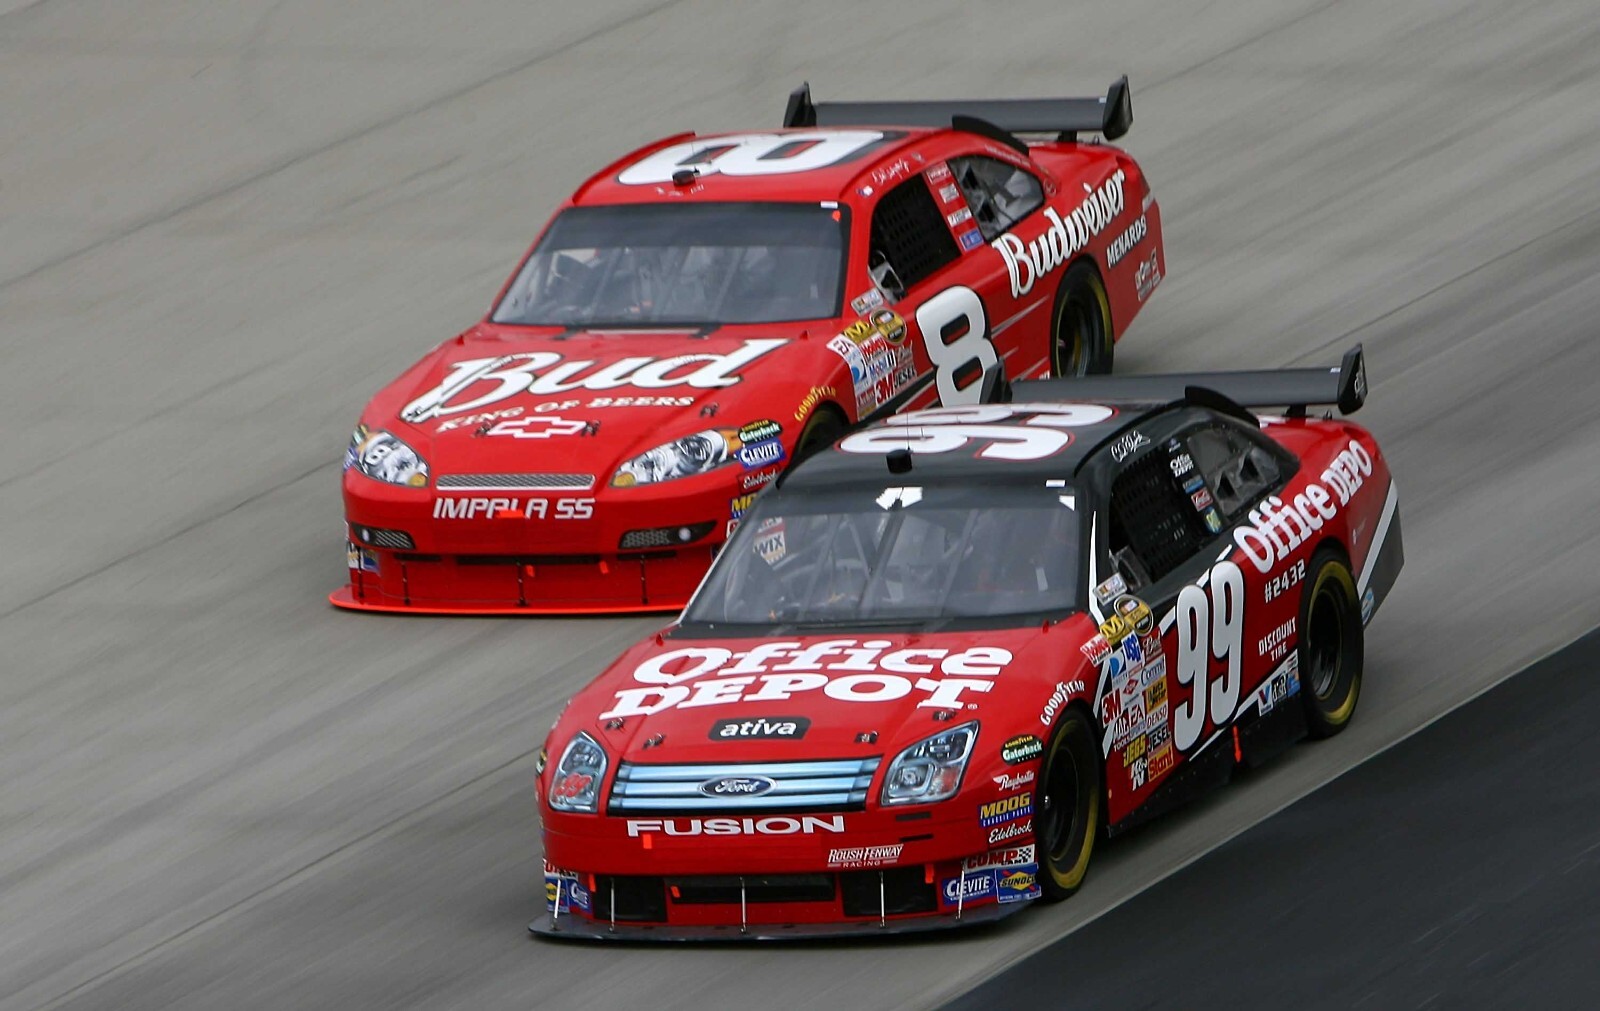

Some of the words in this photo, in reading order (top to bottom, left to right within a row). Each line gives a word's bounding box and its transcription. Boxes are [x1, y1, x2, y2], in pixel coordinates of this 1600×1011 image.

[616, 130, 884, 186] 8
[991, 169, 1126, 299] Budweiser
[1106, 214, 1147, 269] MENARDS
[916, 285, 1000, 407] 8
[398, 338, 790, 423] Bud
[875, 373, 895, 404] 3M
[534, 399, 580, 412] OF
[587, 396, 694, 408] BEERS
[794, 385, 836, 422] GOODYEAR
[554, 498, 595, 520] SS
[1233, 484, 1337, 574] Office
[1264, 559, 1306, 603] #2432
[1258, 616, 1296, 656] DISCOUNT
[1271, 641, 1287, 661] TIRE
[633, 640, 1013, 686] Office
[1174, 560, 1244, 751] 99
[598, 675, 995, 720] DEPOT
[1040, 679, 1085, 726] GOODYEAR
[1103, 688, 1121, 724] 3M
[720, 719, 798, 737] ativa
[1148, 725, 1170, 751] JESEL
[1003, 741, 1043, 761] Gatorback
[714, 778, 760, 796] Ford
[981, 792, 1031, 819] MOOG
[627, 816, 845, 837] FUSION
[989, 819, 1033, 843] Edelbrock
[828, 848, 864, 863] ROUSH
[864, 844, 904, 861] FENWAY
[843, 860, 880, 868] RACING
[947, 876, 991, 897] CLEVITE
